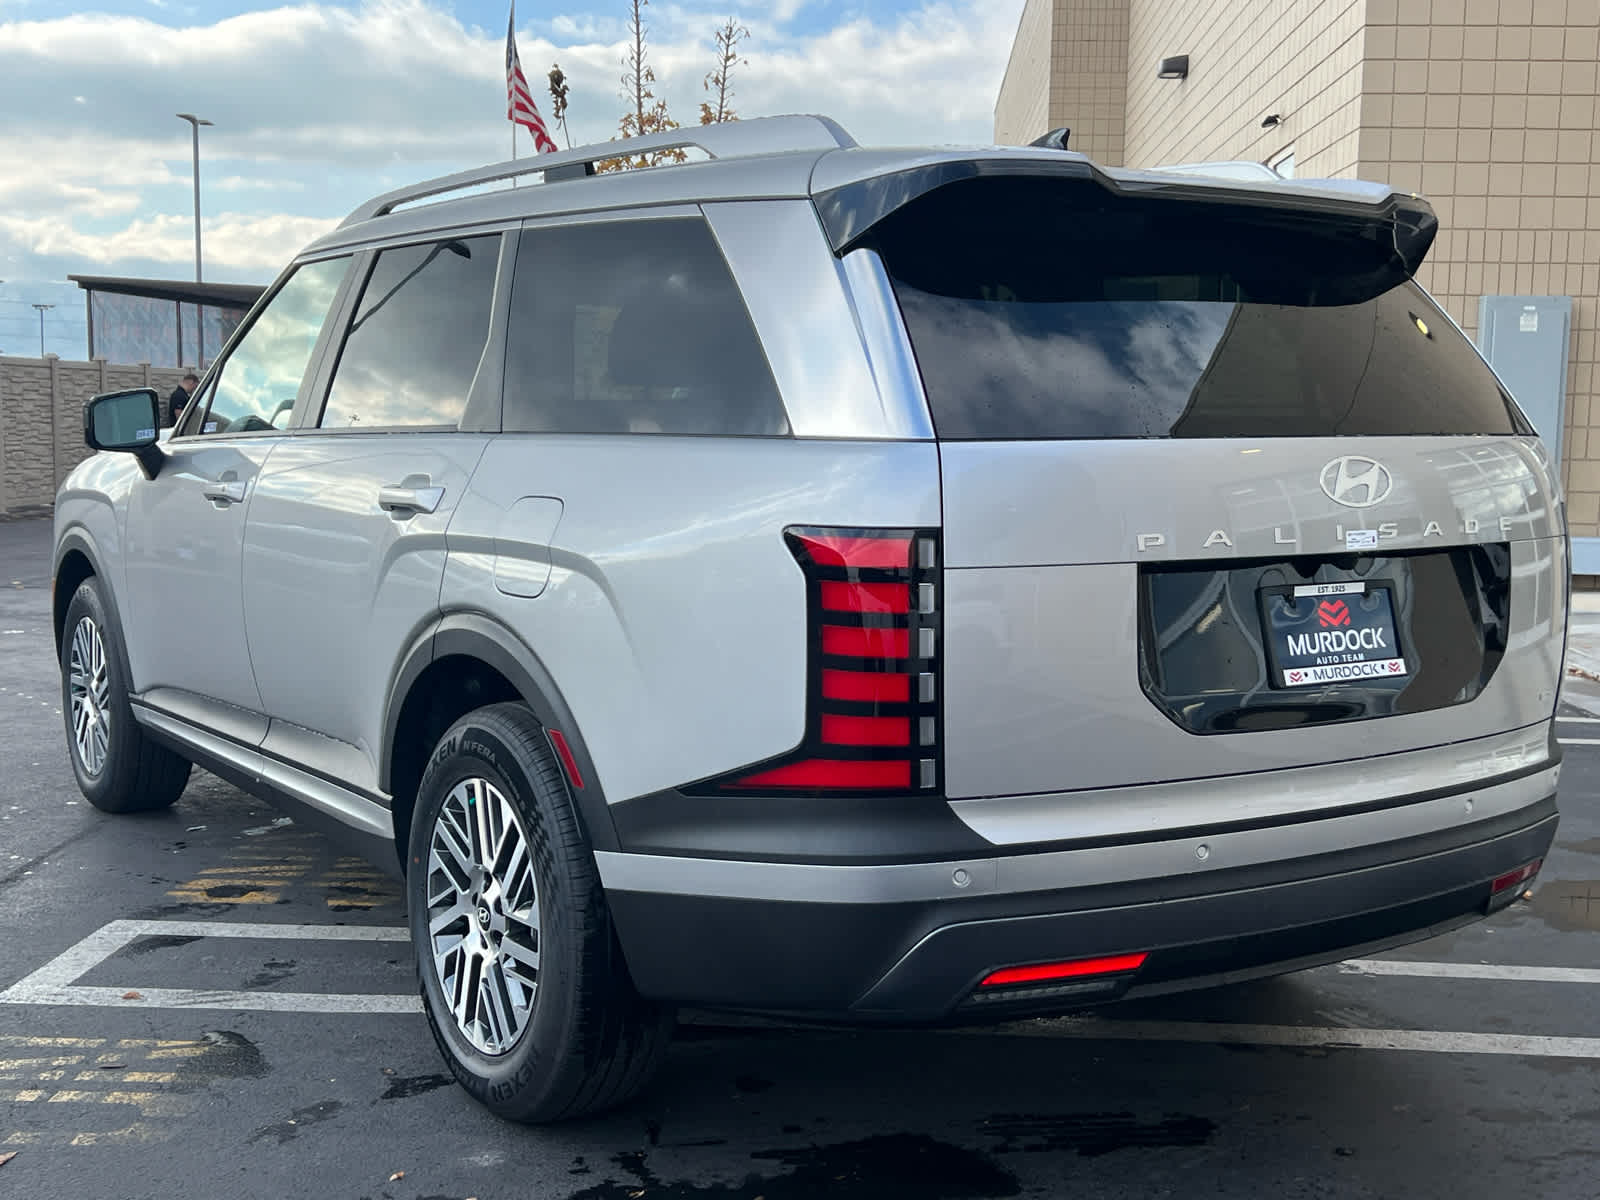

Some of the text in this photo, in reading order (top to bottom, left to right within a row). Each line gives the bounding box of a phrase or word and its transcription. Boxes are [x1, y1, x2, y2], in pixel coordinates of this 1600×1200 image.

[1136, 516, 1512, 552] PALISADE
[1332, 584, 1346, 593] 1925
[1287, 627, 1386, 656] MURDOCK
[1316, 653, 1364, 665] AUTO TEAM
[1313, 663, 1378, 681] MURDOCK
